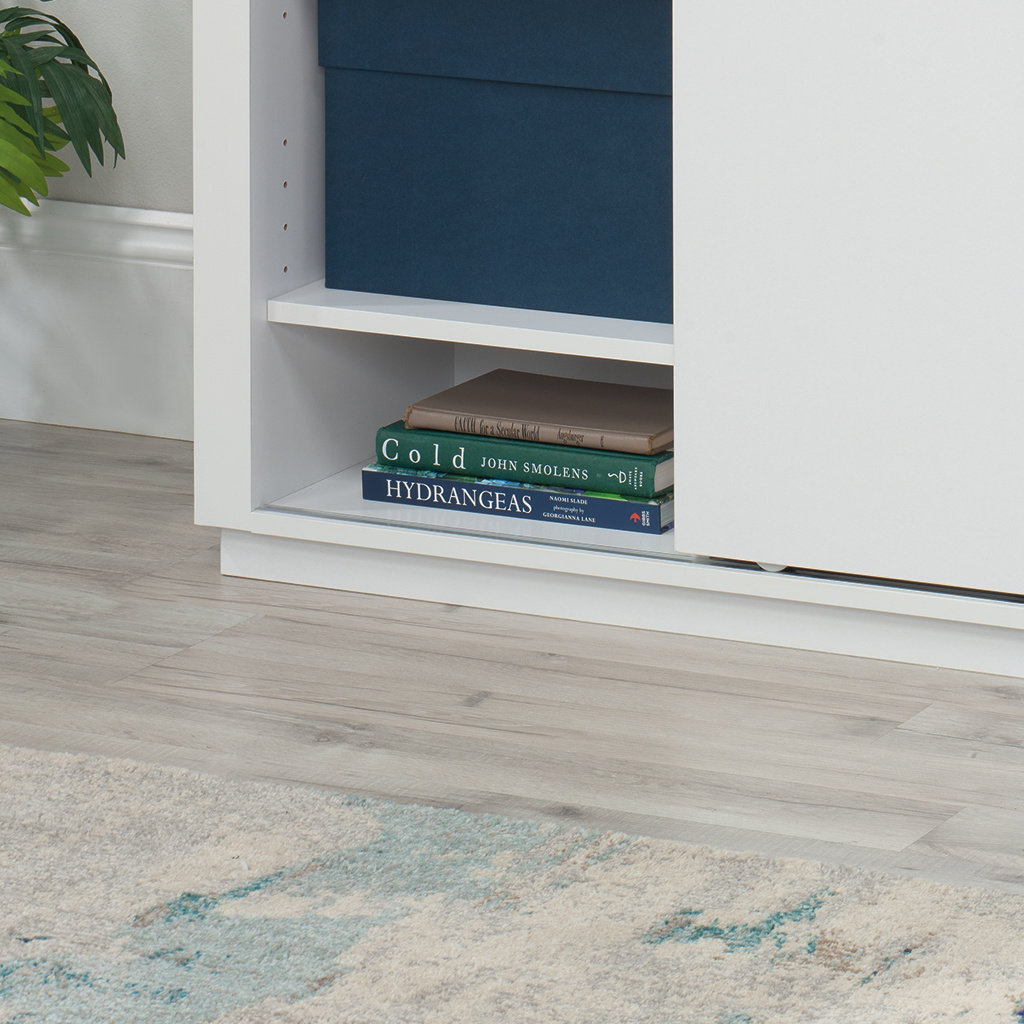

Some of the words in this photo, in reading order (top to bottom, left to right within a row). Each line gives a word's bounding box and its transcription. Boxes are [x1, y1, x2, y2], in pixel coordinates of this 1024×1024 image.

[381, 438, 466, 470] Cold
[480, 456, 518, 472] JOHN
[523, 461, 589, 481] SMOLENS
[386, 479, 532, 514] HYDRANGEAS
[549, 495, 569, 503] NAOMI
[569, 497, 588, 505] SLADE
[542, 511, 580, 521] GEORGIANNA
